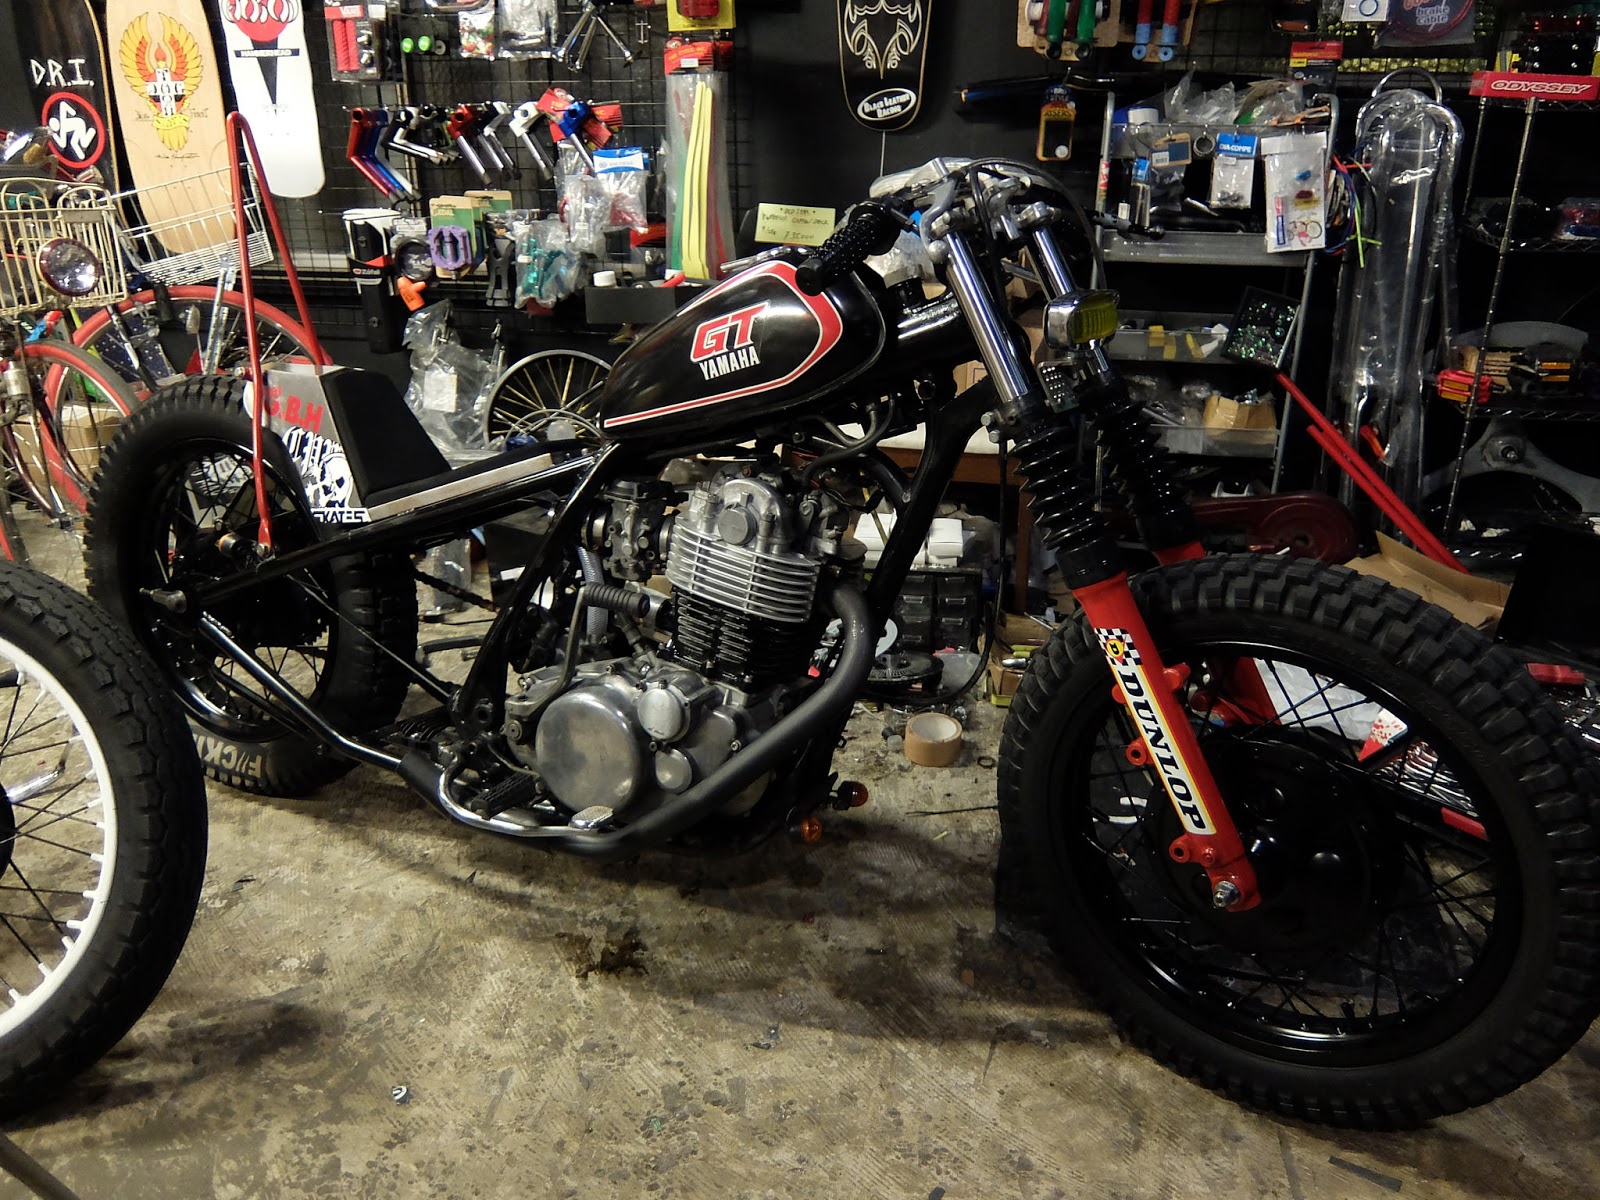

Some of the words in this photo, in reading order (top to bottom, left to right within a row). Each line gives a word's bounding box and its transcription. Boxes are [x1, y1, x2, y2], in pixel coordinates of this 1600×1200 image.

[1416, 5, 1450, 17] brake
[1416, 14, 1449, 25] cable
[1491, 80, 1592, 94] ODYSSEY
[690, 301, 770, 362] GT
[699, 345, 761, 381] YAMAHA
[1117, 669, 1207, 830] DUNLOP
